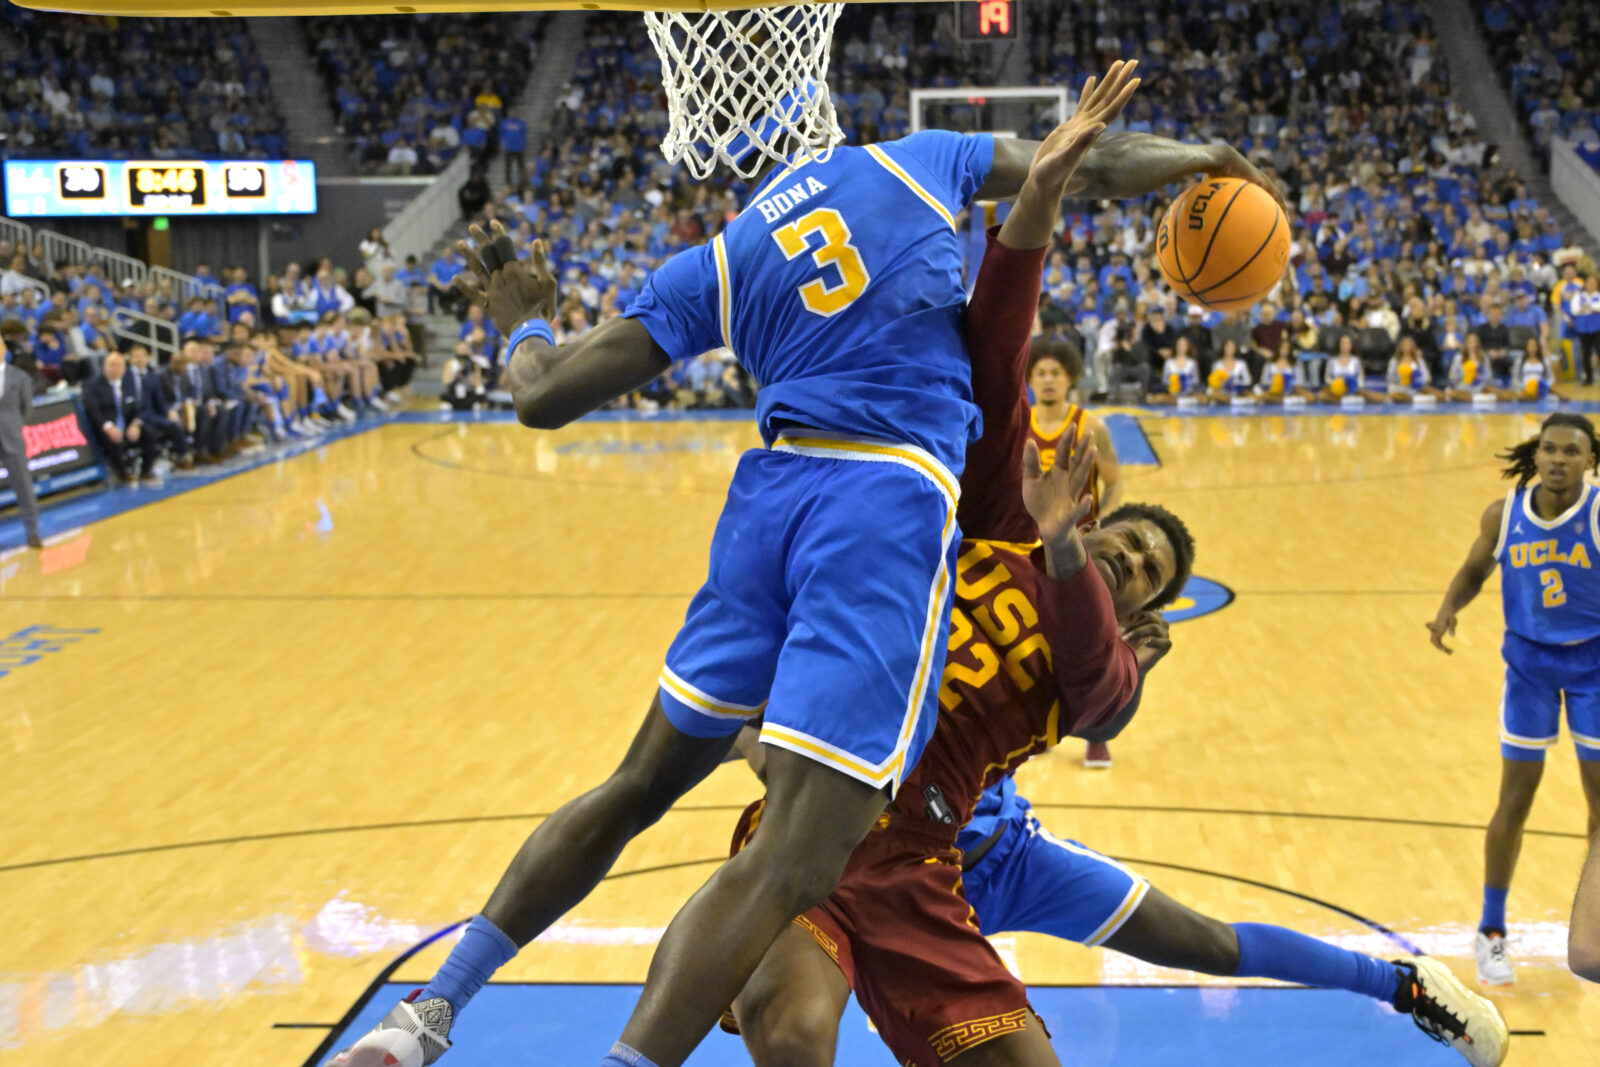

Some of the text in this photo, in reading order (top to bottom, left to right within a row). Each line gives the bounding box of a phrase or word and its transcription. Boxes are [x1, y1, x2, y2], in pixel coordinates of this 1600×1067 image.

[980, 1, 1009, 34] 19
[136, 169, 197, 192] 8:46
[756, 176, 828, 224] BONA
[1188, 182, 1222, 230] UCLA
[770, 207, 871, 318] 3
[1509, 539, 1591, 569] UCLA
[1540, 568, 1567, 608] 2
[955, 542, 1053, 692] USC
